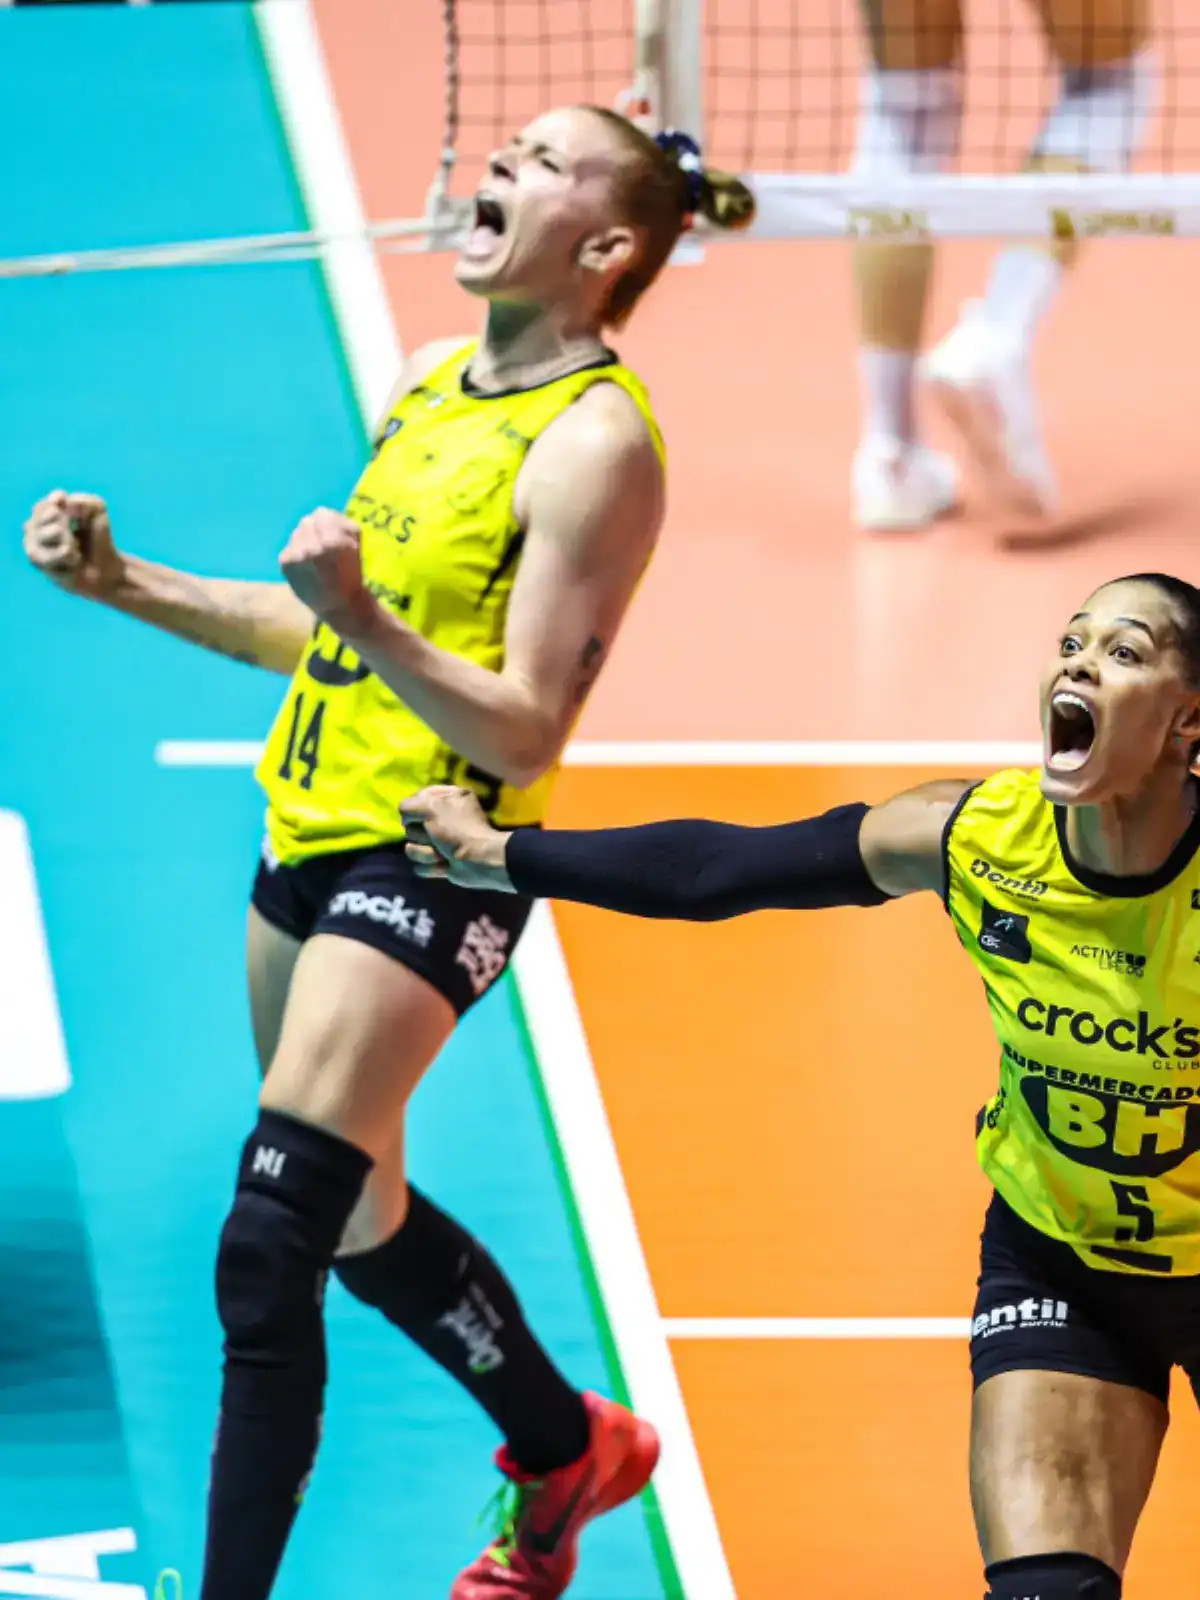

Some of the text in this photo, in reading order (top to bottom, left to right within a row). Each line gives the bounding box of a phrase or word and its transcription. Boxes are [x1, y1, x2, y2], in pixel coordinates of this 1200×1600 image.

[279, 691, 326, 791] 14
[970, 858, 1048, 895] Dentil
[1069, 944, 1125, 960] ACTIVE
[1152, 1059, 1200, 1071] CLUB
[1047, 1084, 1188, 1157] BH
[1110, 1179, 1154, 1243] 5
[972, 1297, 1069, 1337] entil
